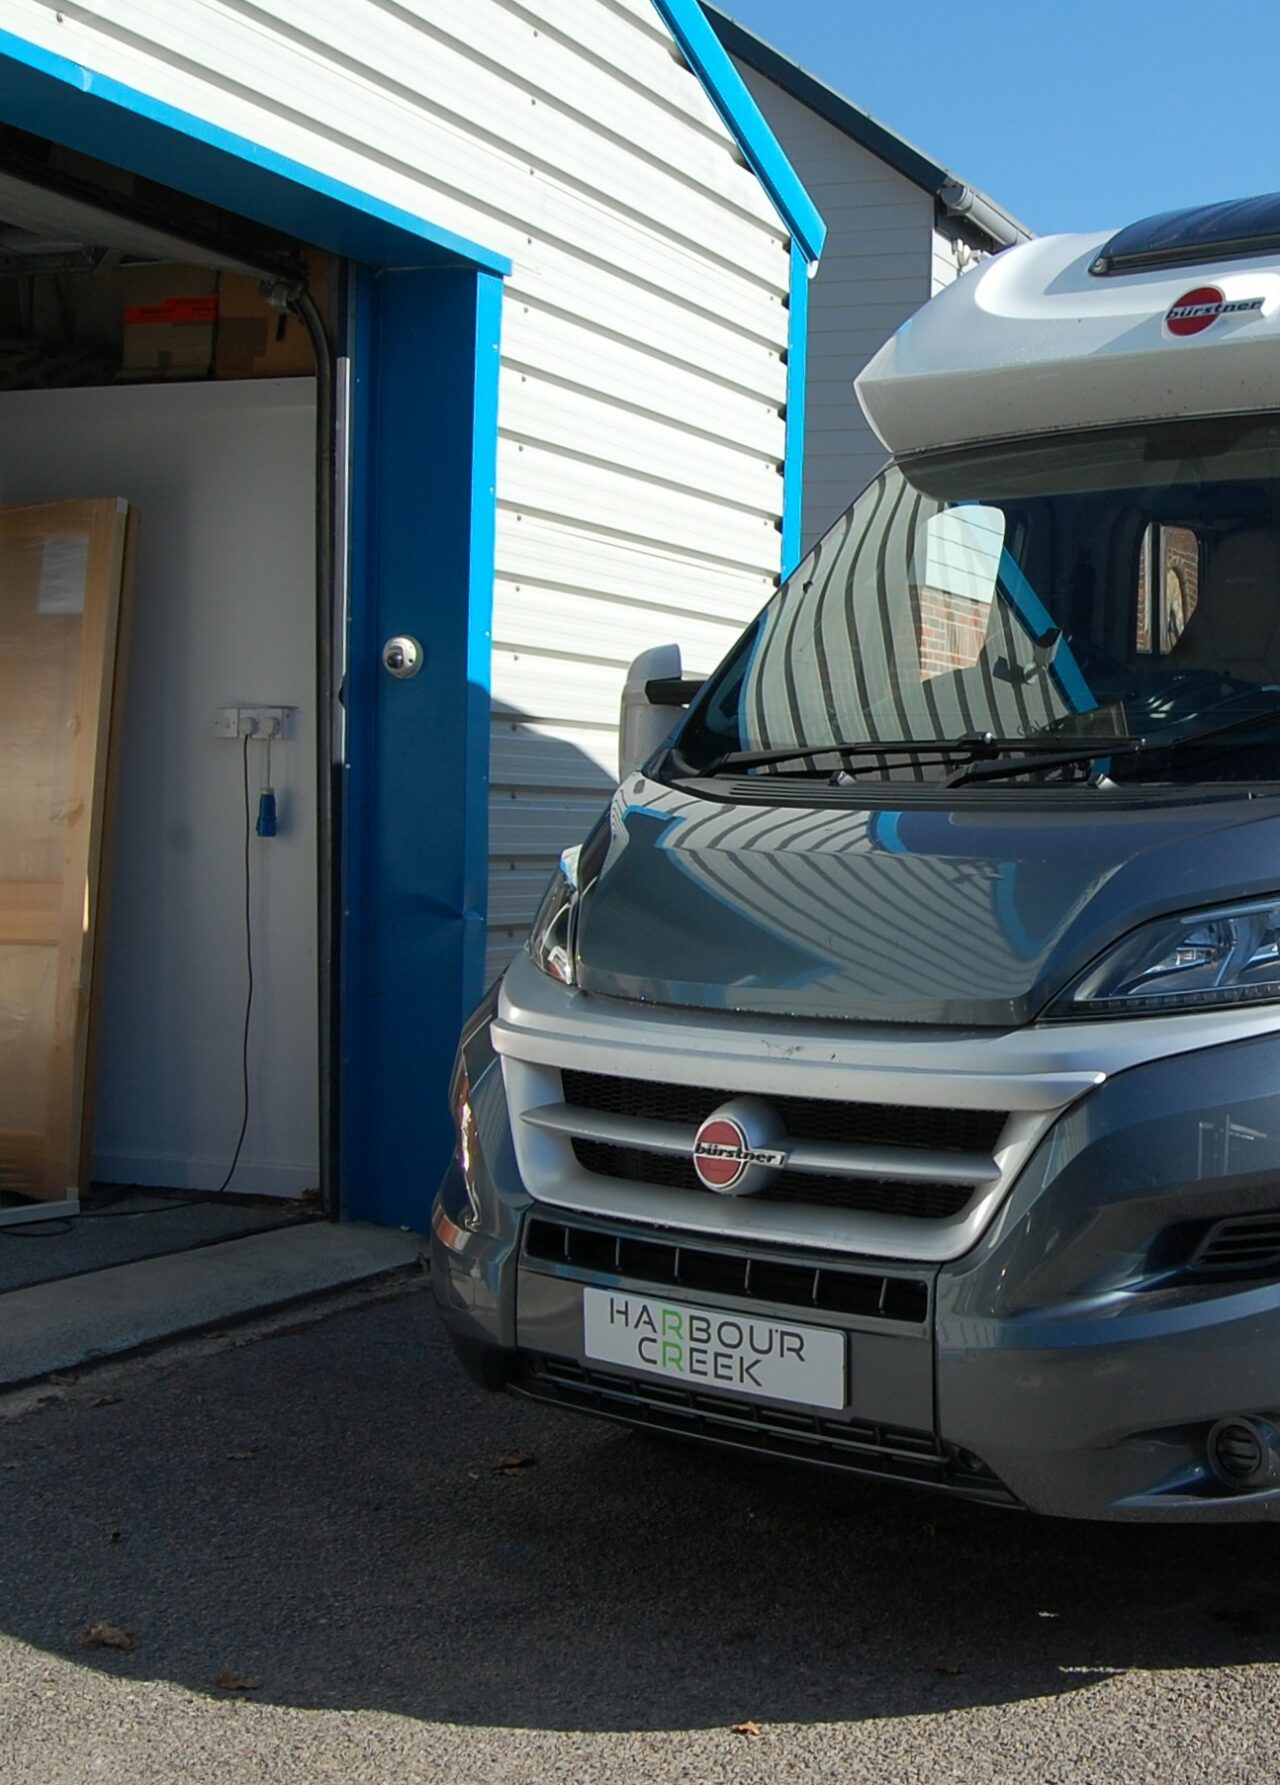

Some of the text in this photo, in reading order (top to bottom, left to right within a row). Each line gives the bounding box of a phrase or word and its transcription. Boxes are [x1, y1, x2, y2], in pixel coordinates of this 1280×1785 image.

[1166, 301, 1261, 319] bürstner
[695, 1143, 777, 1164] bürstner
[610, 1298, 805, 1361] HARBOUR
[638, 1336, 762, 1387] CREEK
